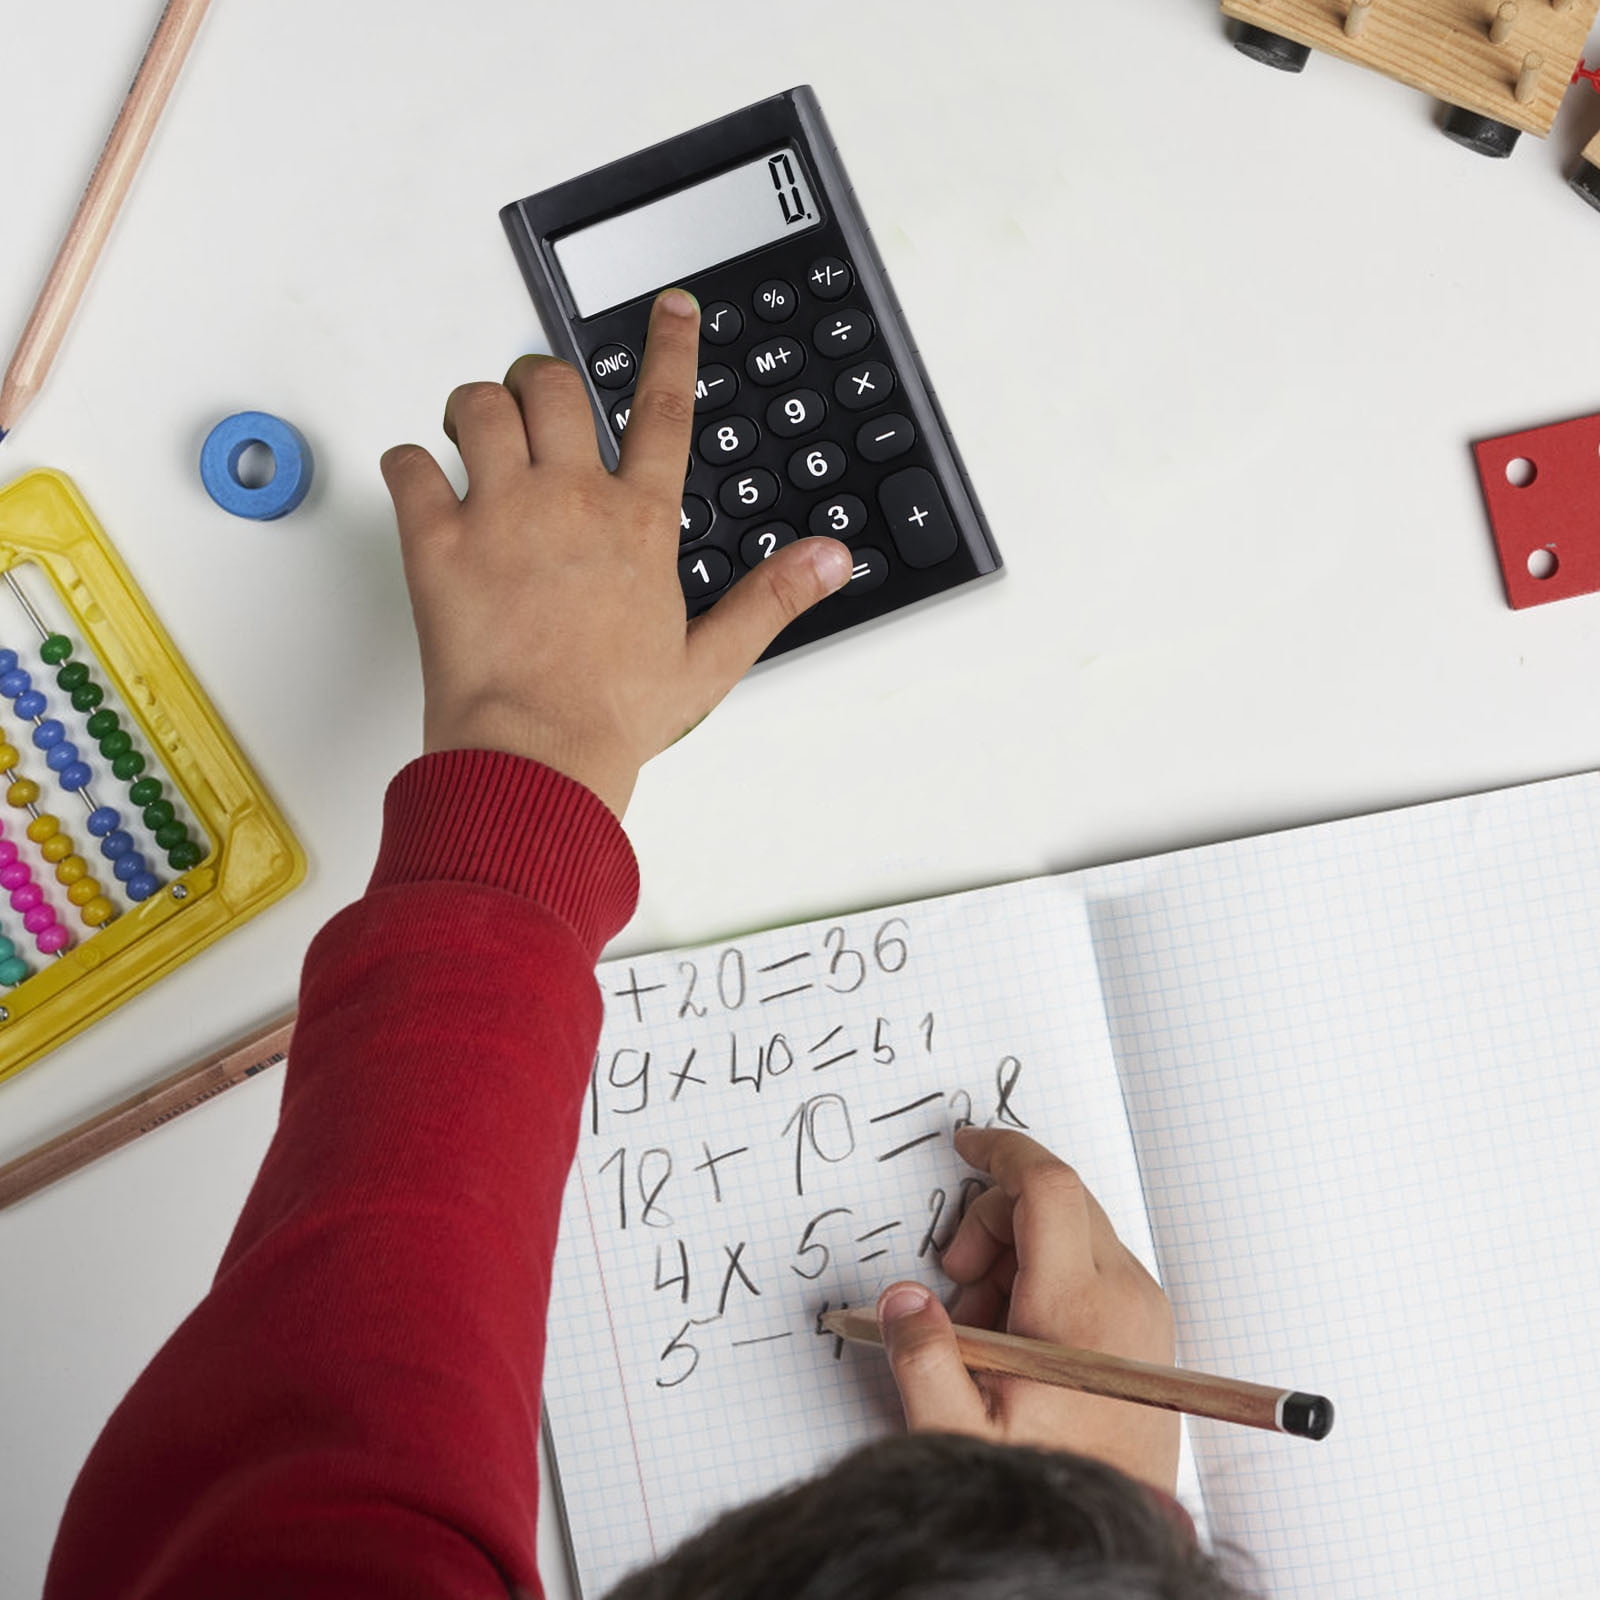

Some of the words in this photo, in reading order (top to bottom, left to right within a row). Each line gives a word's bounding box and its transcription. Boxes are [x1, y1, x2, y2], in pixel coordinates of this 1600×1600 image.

[762, 288, 785, 308] %
[594, 352, 630, 377] ON/C
[755, 347, 792, 374] M+
[784, 398, 806, 424] 9
[717, 426, 739, 452] 8
[806, 451, 828, 477] 6
[737, 477, 759, 504] 5
[827, 505, 849, 530] 3
[758, 532, 777, 559] 2
[691, 559, 711, 584] 1
